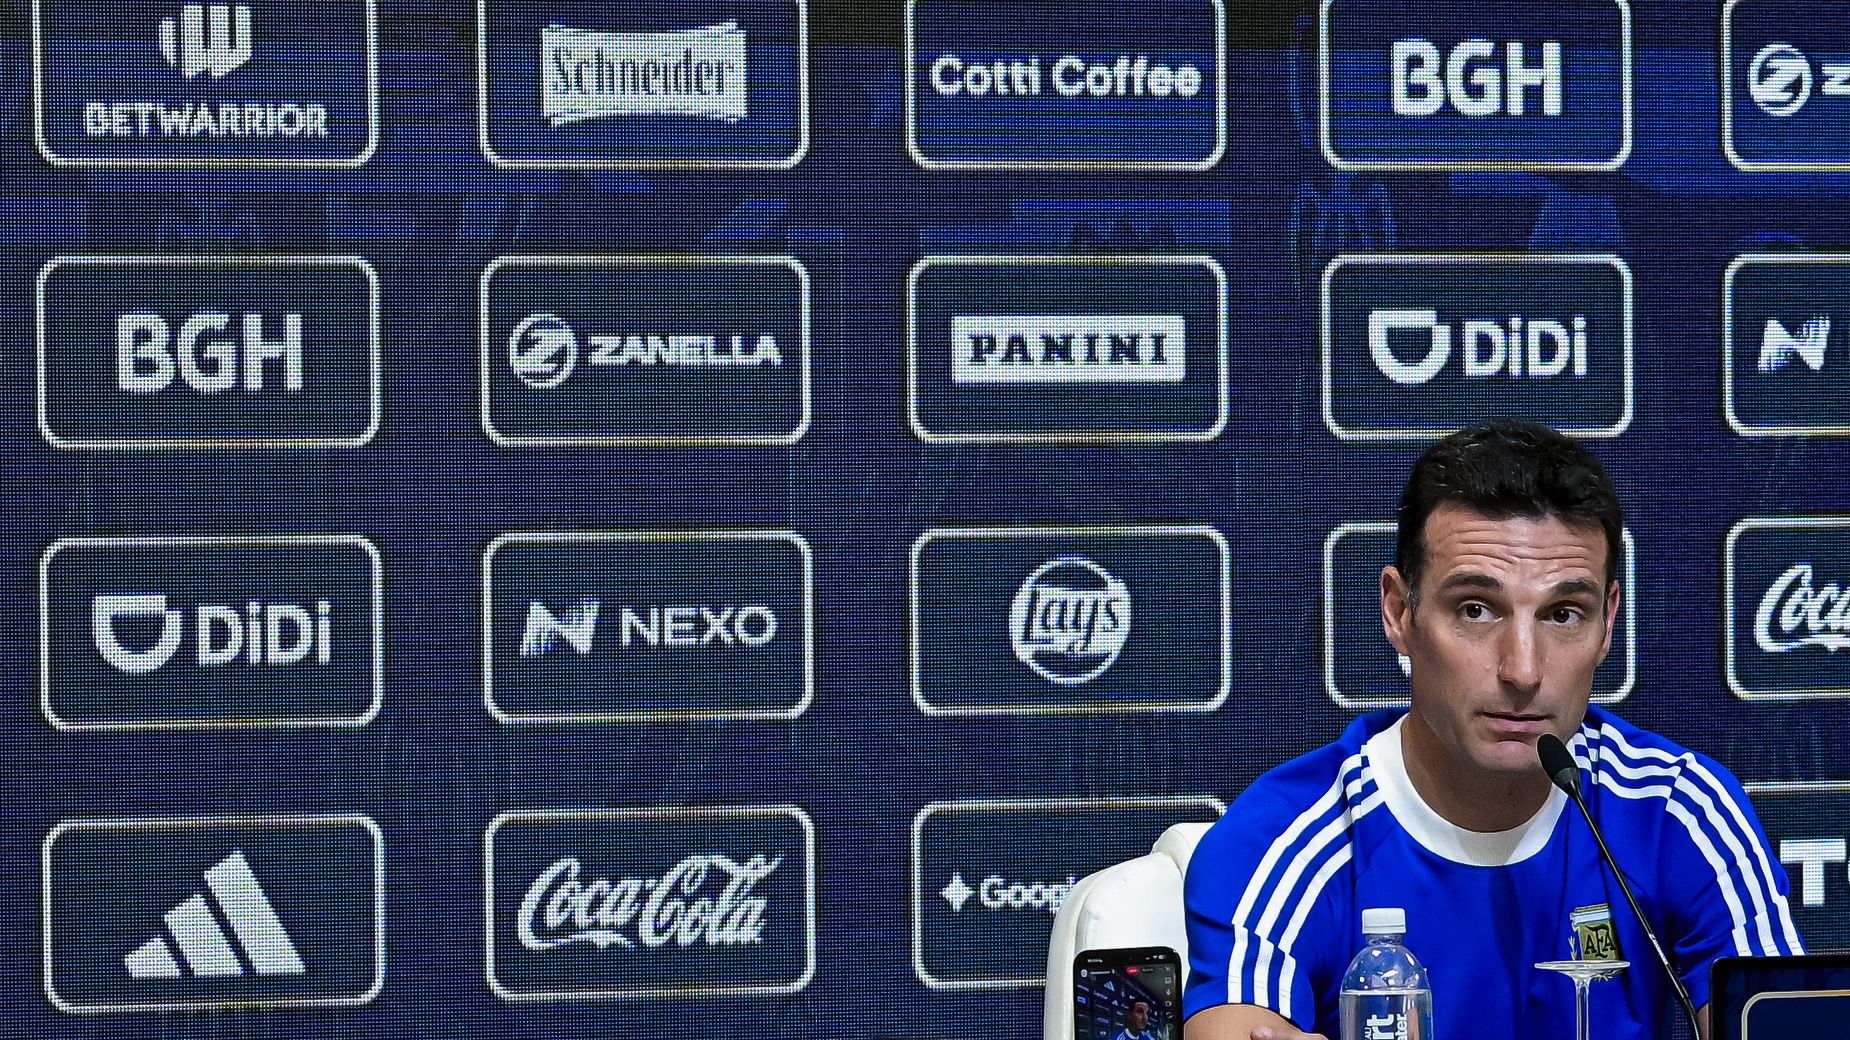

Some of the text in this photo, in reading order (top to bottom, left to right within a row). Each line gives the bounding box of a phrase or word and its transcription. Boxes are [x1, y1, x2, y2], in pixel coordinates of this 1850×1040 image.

[553, 48, 734, 95] Schneider
[931, 55, 1201, 96] Cotti Coffee
[1393, 39, 1561, 116] BGH
[84, 102, 327, 136] BETWARRIOR
[118, 313, 302, 392] BGH
[590, 335, 781, 365] ZANELLA
[970, 334, 1165, 364] PANINI
[1464, 317, 1587, 376] DiDi
[198, 600, 330, 665] DiDi
[621, 605, 777, 646] NEXO
[1584, 922, 1616, 958] AFA
